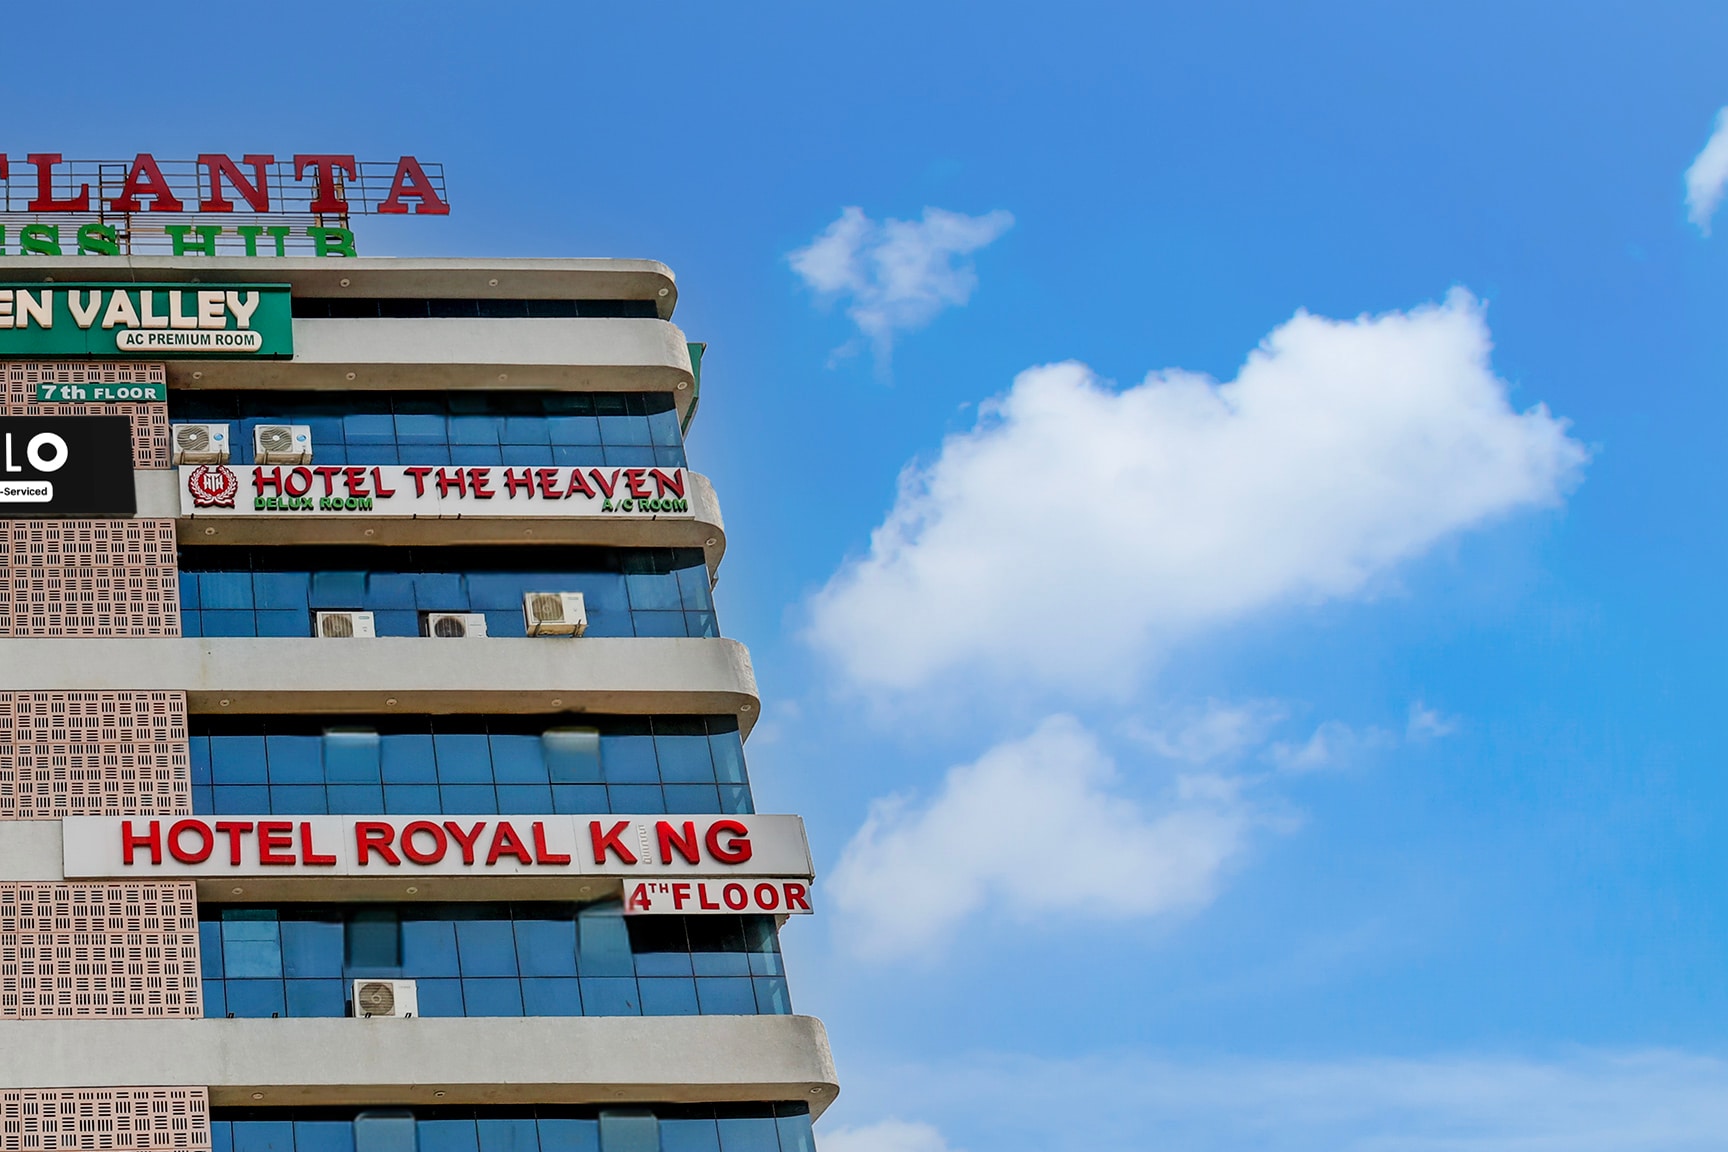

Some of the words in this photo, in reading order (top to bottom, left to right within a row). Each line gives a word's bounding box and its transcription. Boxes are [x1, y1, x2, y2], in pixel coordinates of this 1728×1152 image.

[67, 289, 261, 330] VALLEY
[126, 333, 144, 345] AC
[148, 333, 211, 345] PREMIUM
[215, 334, 255, 346] ROOM
[93, 387, 158, 400] FLOOR
[252, 466, 396, 498] HOTEL
[404, 467, 496, 499] THE
[504, 468, 686, 500] HEAVEN
[253, 497, 315, 512] DELUX
[320, 497, 373, 512] ROOM
[601, 498, 634, 513] A/C
[638, 499, 689, 513] ROOM
[120, 818, 337, 867] HOTEL
[355, 818, 572, 867] ROYAL
[672, 882, 811, 911] FLOOR
